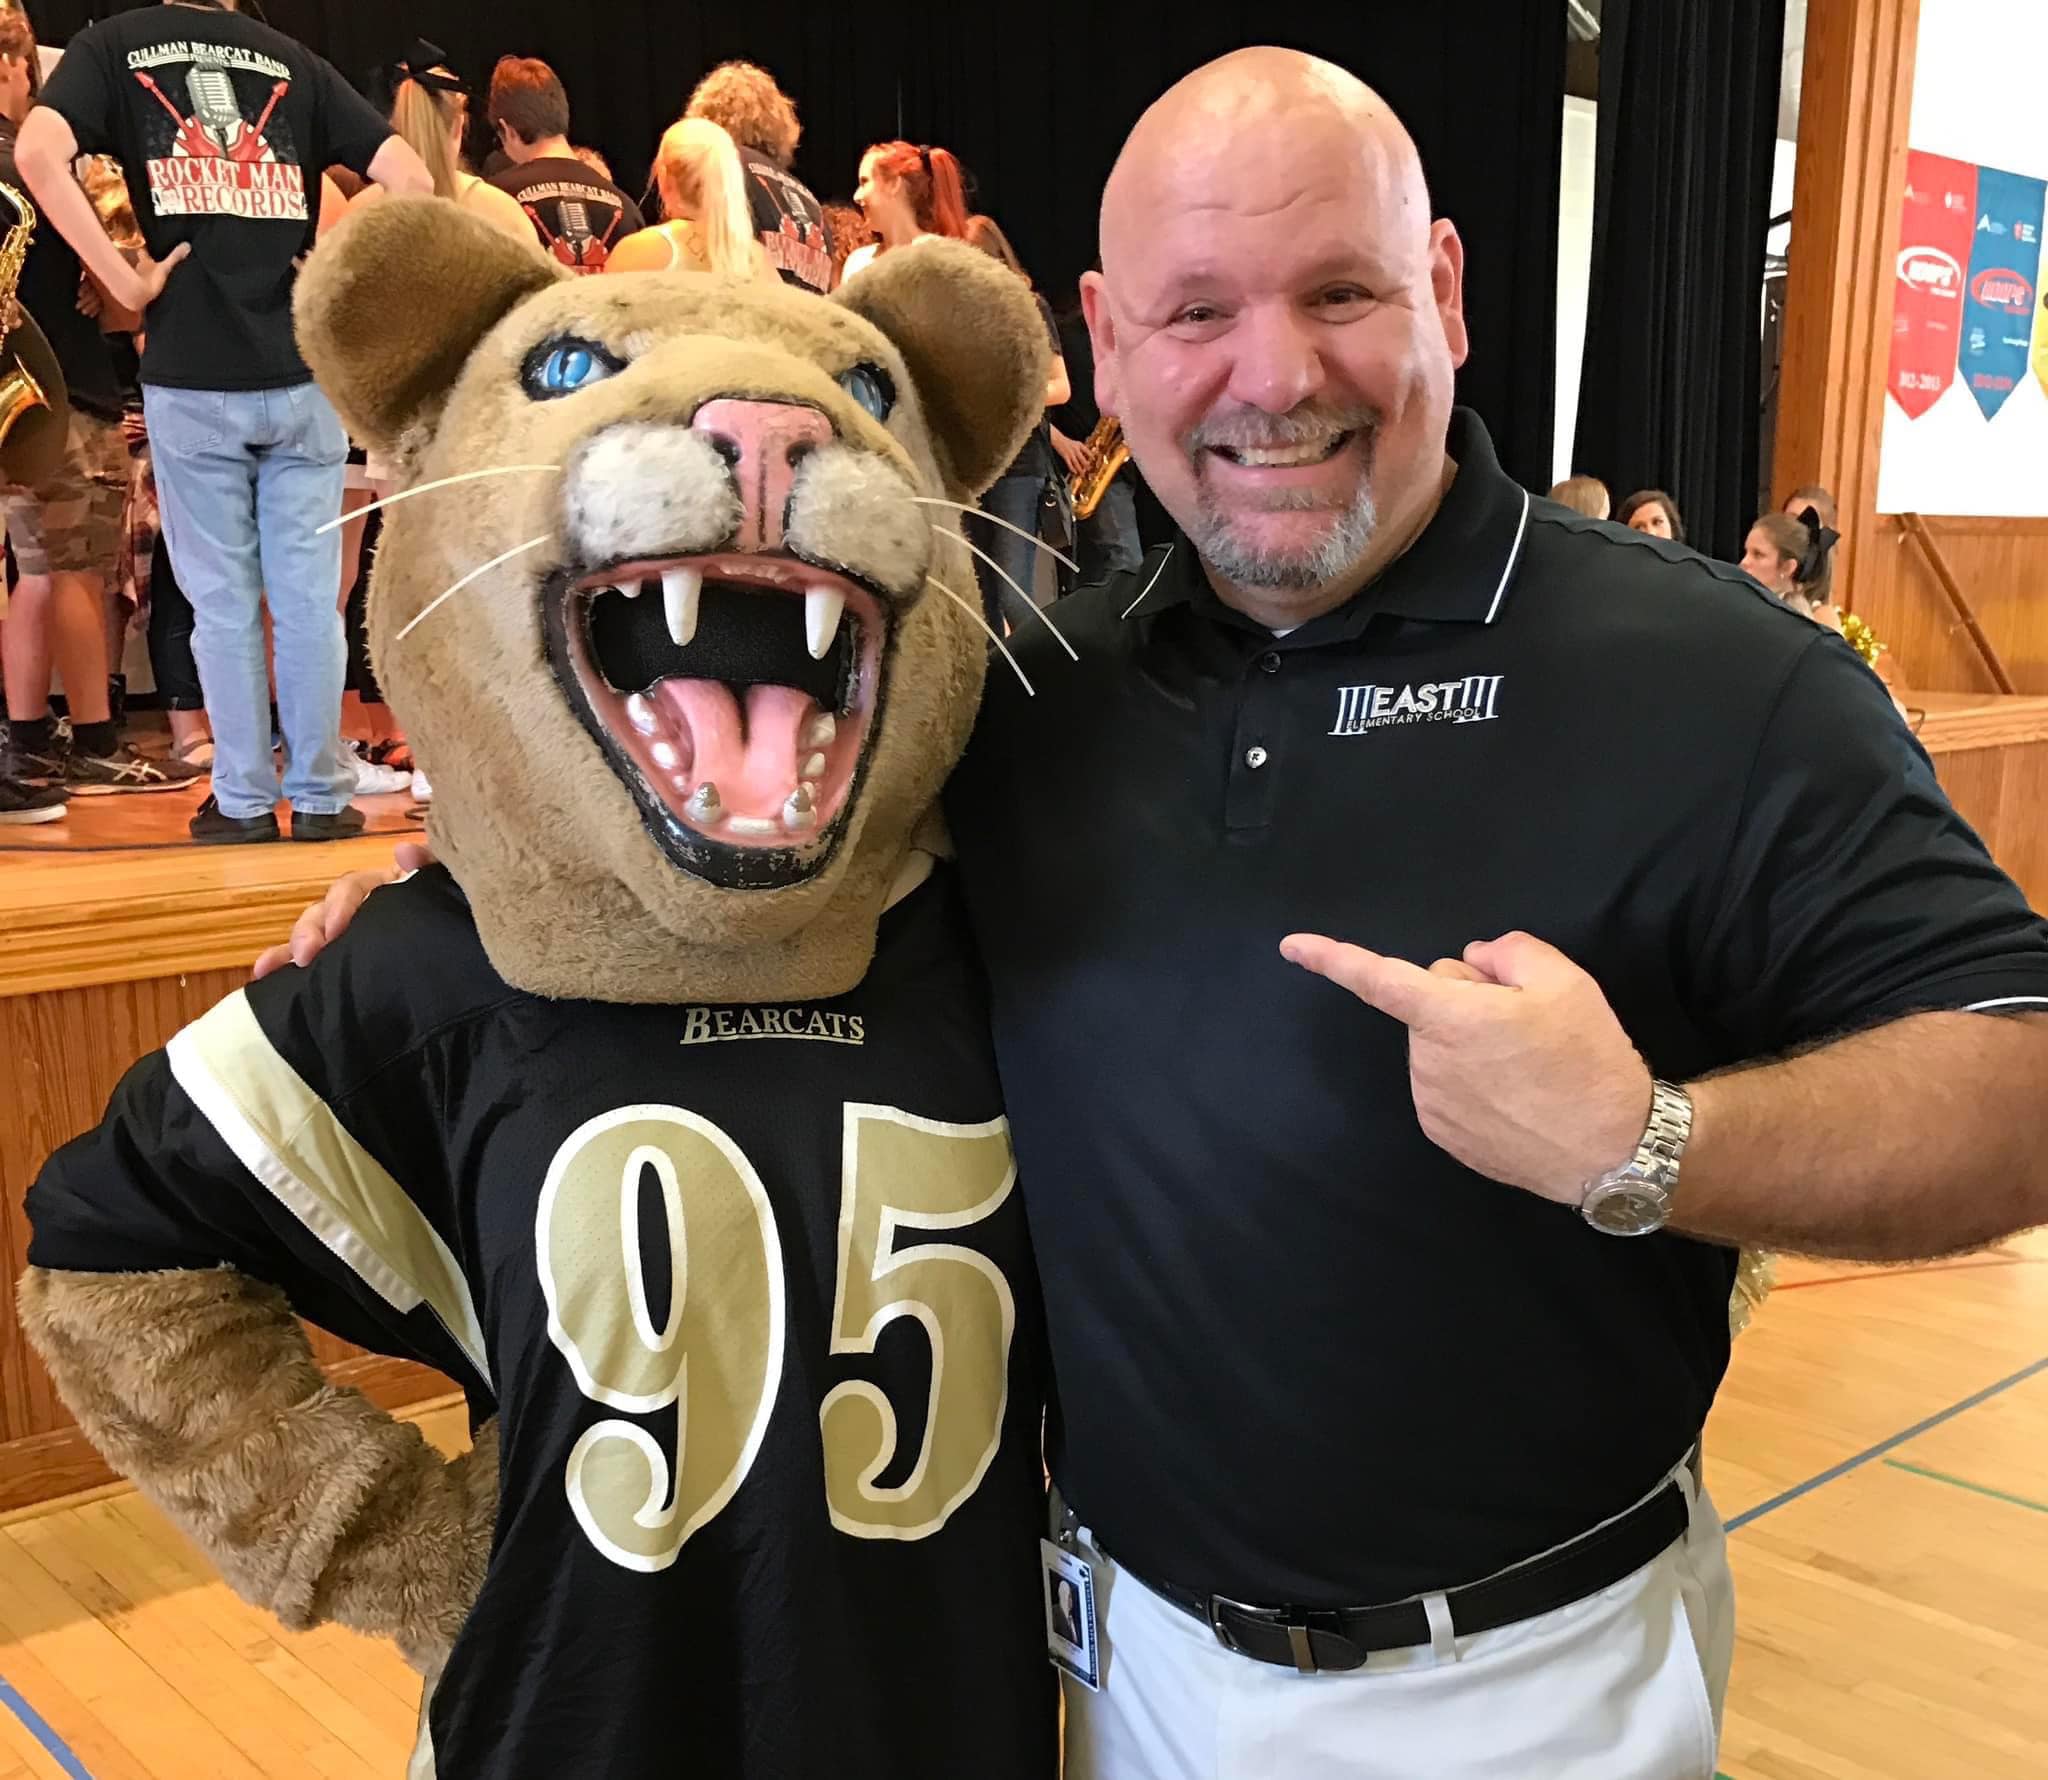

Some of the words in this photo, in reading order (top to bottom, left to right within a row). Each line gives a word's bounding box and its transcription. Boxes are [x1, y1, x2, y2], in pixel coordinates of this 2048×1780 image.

[127, 41, 188, 66] CULLMAN
[190, 41, 251, 62] BEARCAT
[254, 51, 291, 77] BAND
[148, 157, 241, 189] ROCKET
[249, 162, 303, 193] MAN
[182, 186, 301, 218] RECORDS
[1346, 712, 1422, 730] ELEMENTARY
[1426, 706, 1481, 723] SCHOOL
[1370, 682, 1463, 718] EAST
[680, 1007, 865, 1042] BEARCATS
[535, 1101, 1018, 1573] 95
